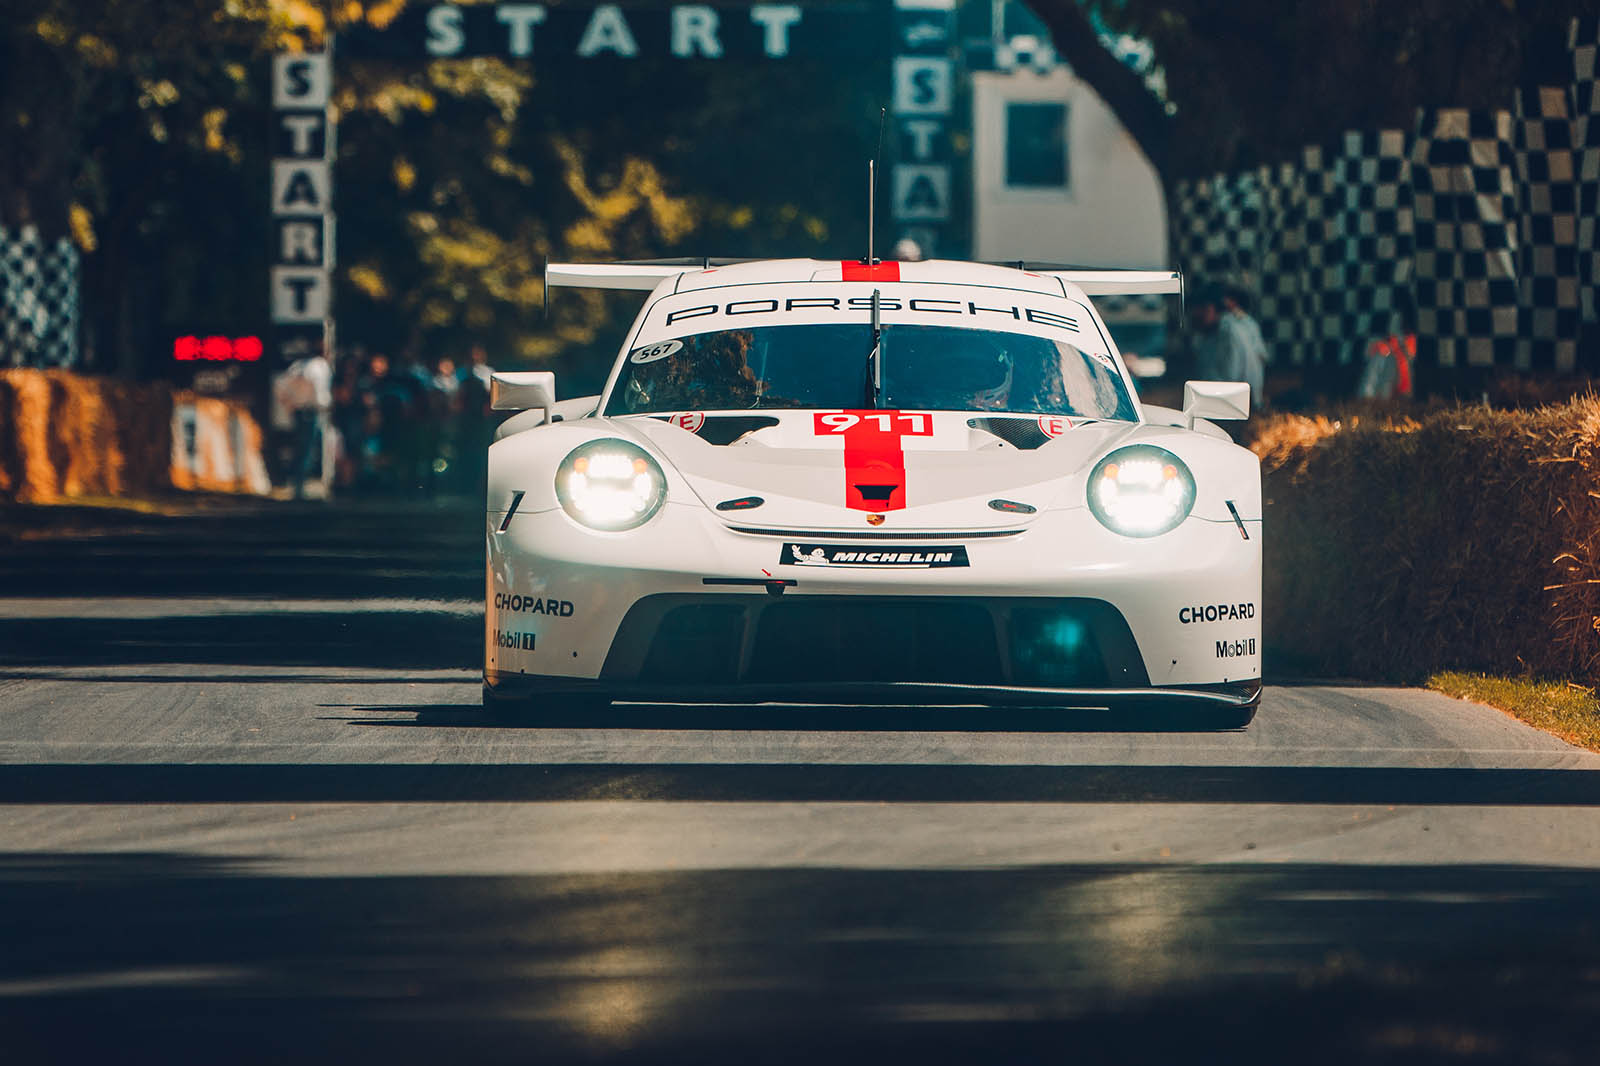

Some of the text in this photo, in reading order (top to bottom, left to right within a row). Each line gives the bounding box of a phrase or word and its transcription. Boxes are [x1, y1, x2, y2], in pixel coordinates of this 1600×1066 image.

[424, 5, 802, 58] START
[280, 61, 320, 315] START
[665, 297, 1079, 332] PORSCHE
[639, 343, 673, 360] 567
[679, 414, 695, 431] E
[821, 414, 925, 433] 911
[1049, 419, 1065, 436] E
[832, 552, 953, 564] MICHELIN
[494, 592, 575, 618] CHOPARD
[1178, 603, 1255, 624] CHOPARD
[493, 629, 520, 649] Mobil
[1215, 640, 1247, 659] Mobil
